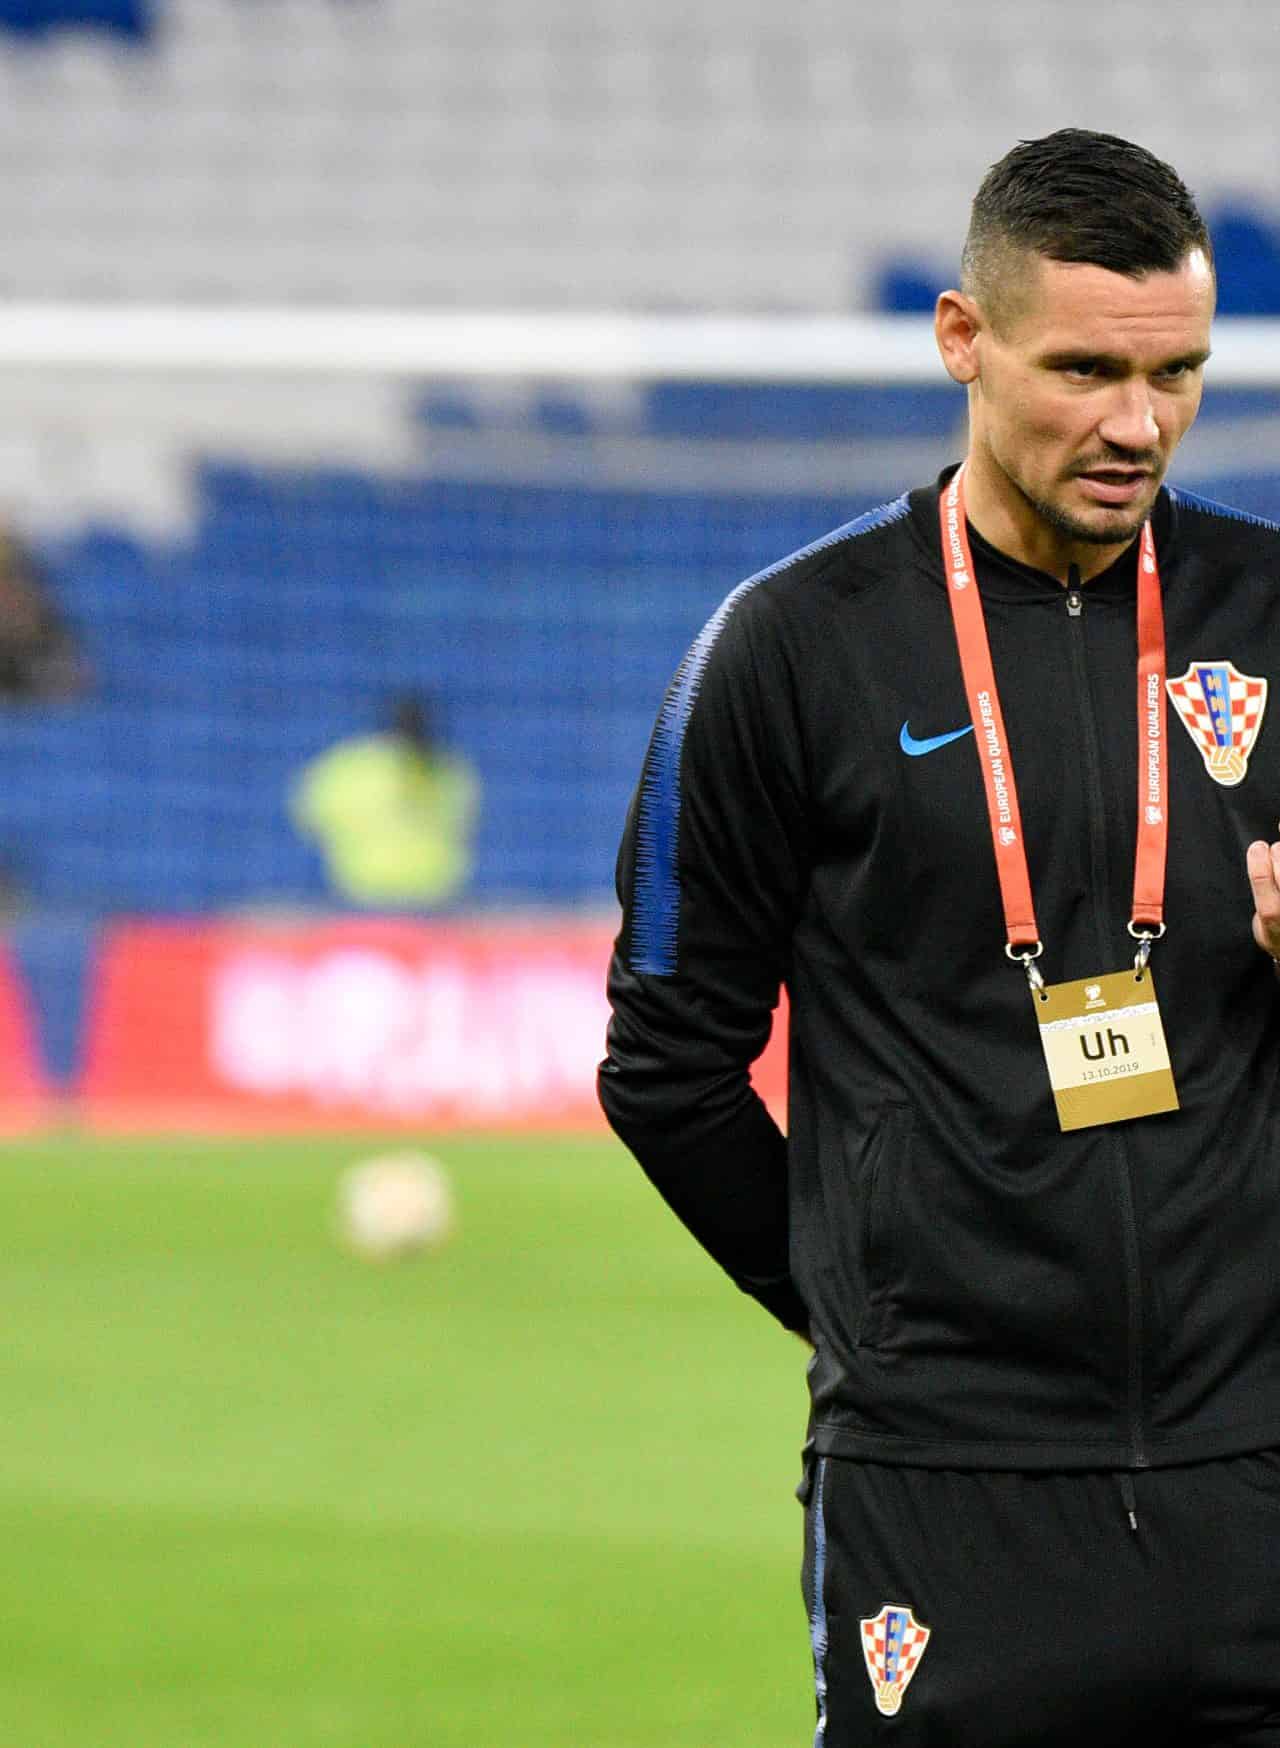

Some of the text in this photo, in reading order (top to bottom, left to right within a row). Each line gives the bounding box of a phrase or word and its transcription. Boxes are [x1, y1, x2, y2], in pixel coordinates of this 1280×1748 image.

[947, 508, 965, 569] EUROPEAN
[977, 690, 1011, 824] EUROPEAN QUALIFIERS
[1147, 672, 1160, 803] EUROPEAN QUALIFIERS
[1080, 1028, 1130, 1060] Uh
[1082, 1062, 1139, 1080] 13.10.2019
